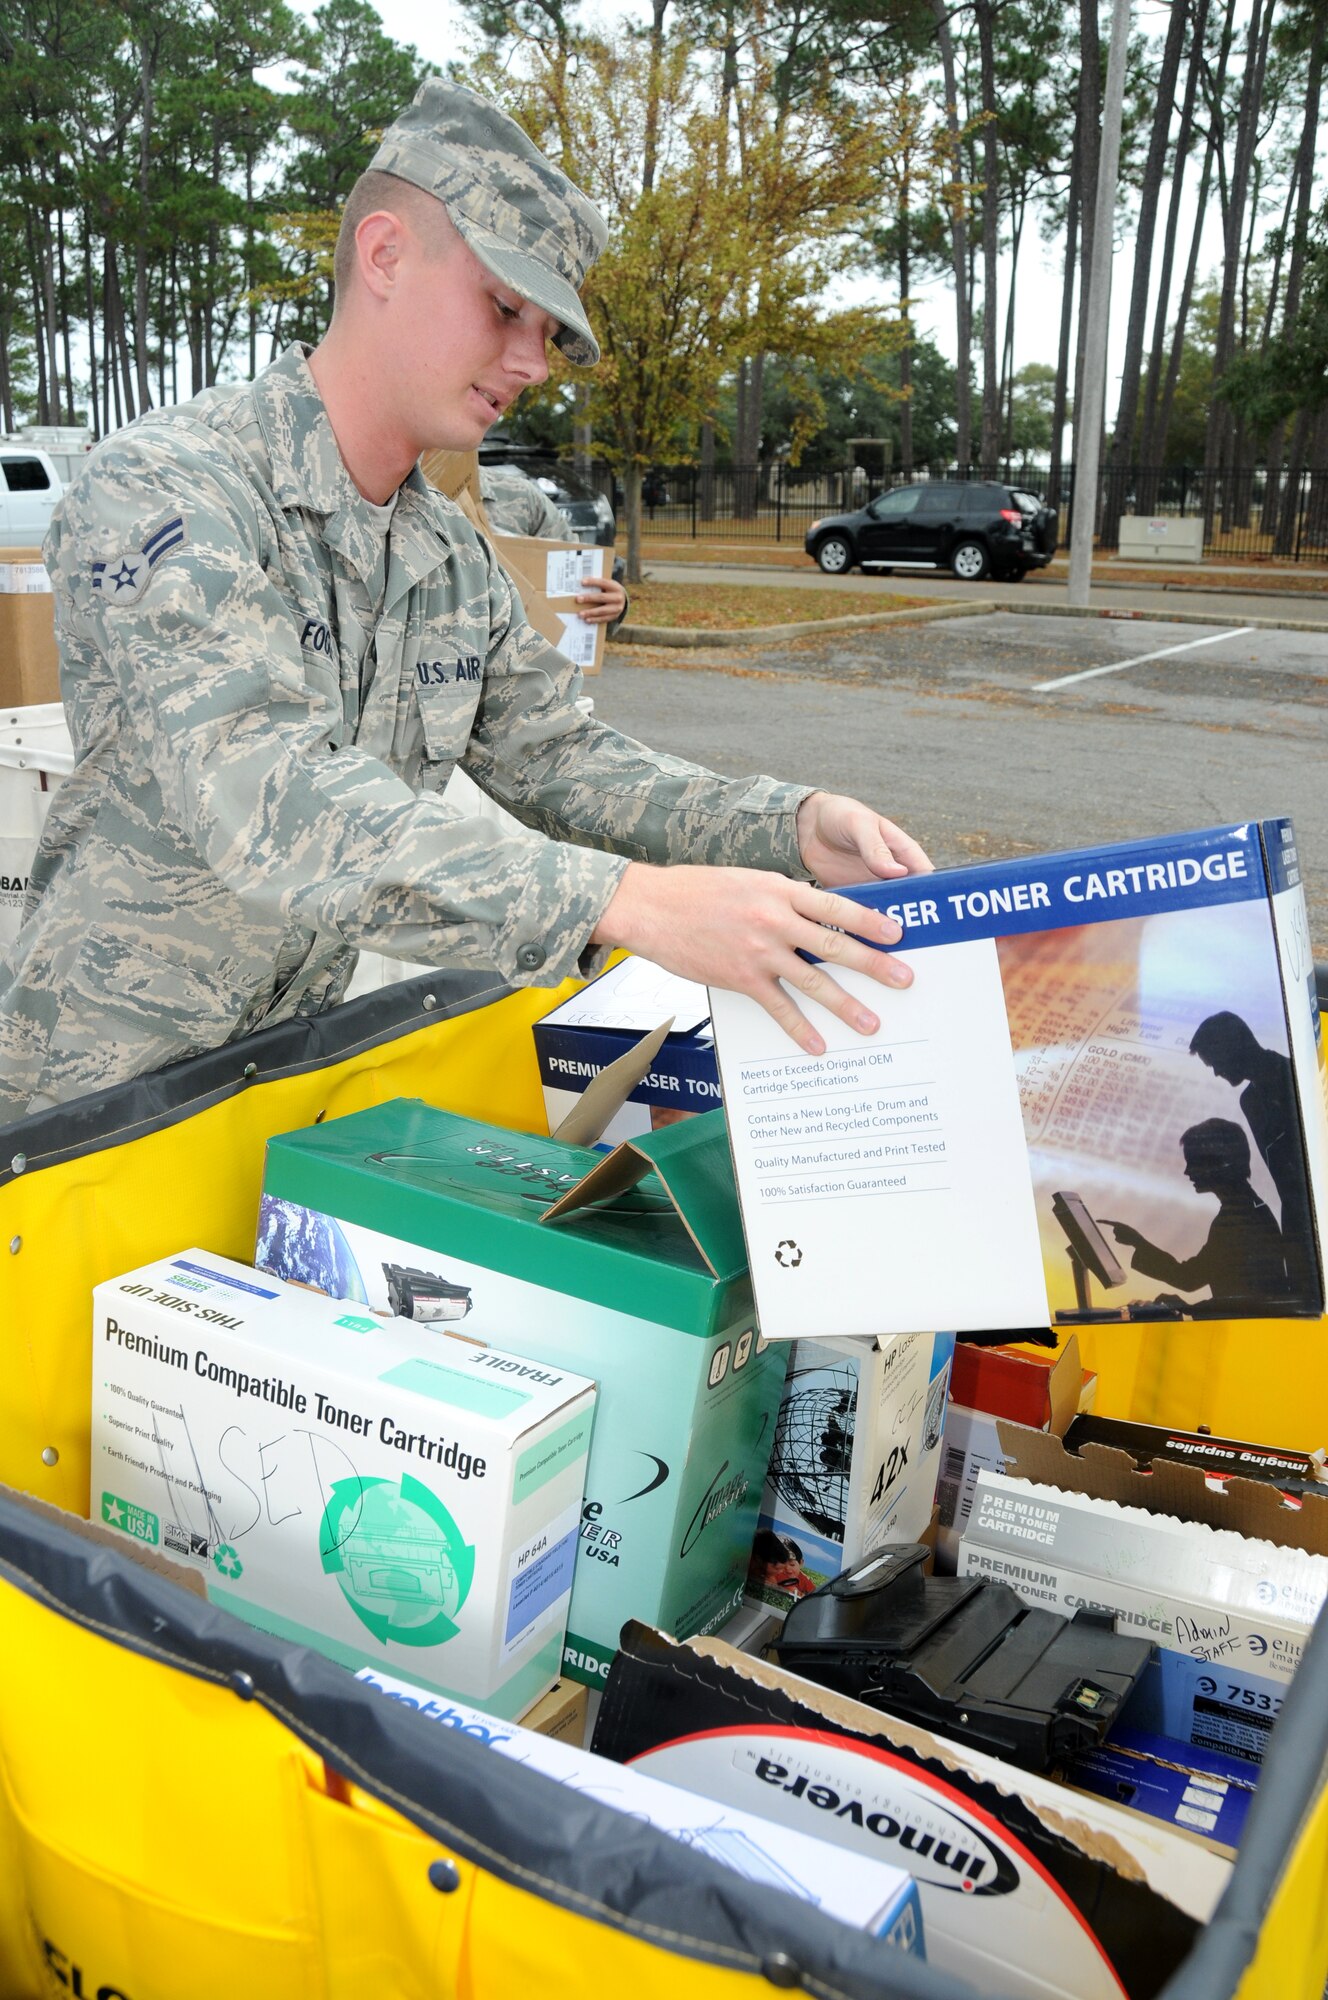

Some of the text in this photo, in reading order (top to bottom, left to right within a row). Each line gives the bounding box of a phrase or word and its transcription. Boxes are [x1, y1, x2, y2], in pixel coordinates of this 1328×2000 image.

[417, 656, 480, 685] U.S. AIR
[0, 876, 29, 890] BA
[874, 899, 940, 928] SER
[948, 881, 1051, 920] TONER
[1063, 850, 1248, 903] CARTRIDGE
[1088, 1045, 1118, 1058] GOLD
[741, 1053, 893, 1081] Meets or Exceeds Original OEM
[638, 1073, 680, 1092] ASER
[686, 1078, 722, 1099] TON
[743, 1073, 859, 1096] Cartridge Specifications
[747, 1111, 791, 1126] Contains
[800, 1108, 823, 1119] New
[825, 1101, 873, 1118] Long-Life
[877, 1098, 906, 1112] Drum
[909, 1096, 929, 1109] and
[750, 1111, 939, 1140] Other New and Recycled Components
[465, 1145, 580, 1184] ASTER
[754, 1141, 946, 1170] Quality Manufactured and Print Tested
[760, 1175, 907, 1198] 100% Satisfaction Guaranteed
[119, 1283, 245, 1331] THIS SIDE UP
[884, 1333, 921, 1375] HP Laser
[468, 1352, 563, 1387] FRAGILE
[106, 1317, 487, 1480] Premium Compatible Toner Cartridge
[110, 1383, 126, 1398] 100%
[127, 1390, 150, 1409] Quality
[108, 1415, 174, 1451] Superior Print Quality
[519, 1431, 584, 1482] Premium Compatible Toner Cartridge
[1165, 1440, 1308, 1473] imaging supplies
[107, 1446, 222, 1503] Earth Friendly Product and Packaging
[127, 1505, 155, 1523] MADE IN
[980, 1506, 1057, 1533] LASER TONER
[983, 1494, 1060, 1523] PREMIUM
[126, 1517, 155, 1542] USA
[978, 1516, 1055, 1546] CARTRIDGE
[517, 1549, 531, 1569] HP
[531, 1536, 547, 1556] 64A
[585, 1545, 620, 1567] USA
[967, 1553, 1058, 1589] PREMIUM
[1012, 1581, 1058, 1603] TONER
[700, 1600, 731, 1636] RECYCLE
[1190, 1637, 1242, 1665] STAFF
[1272, 1637, 1302, 1657] elit
[1272, 1651, 1301, 1668] imag
[564, 1646, 612, 1680] RIDG
[1191, 1733, 1247, 1758] Compatible
[768, 1747, 978, 1851] essentials technology
[755, 1756, 988, 1892] innovera
